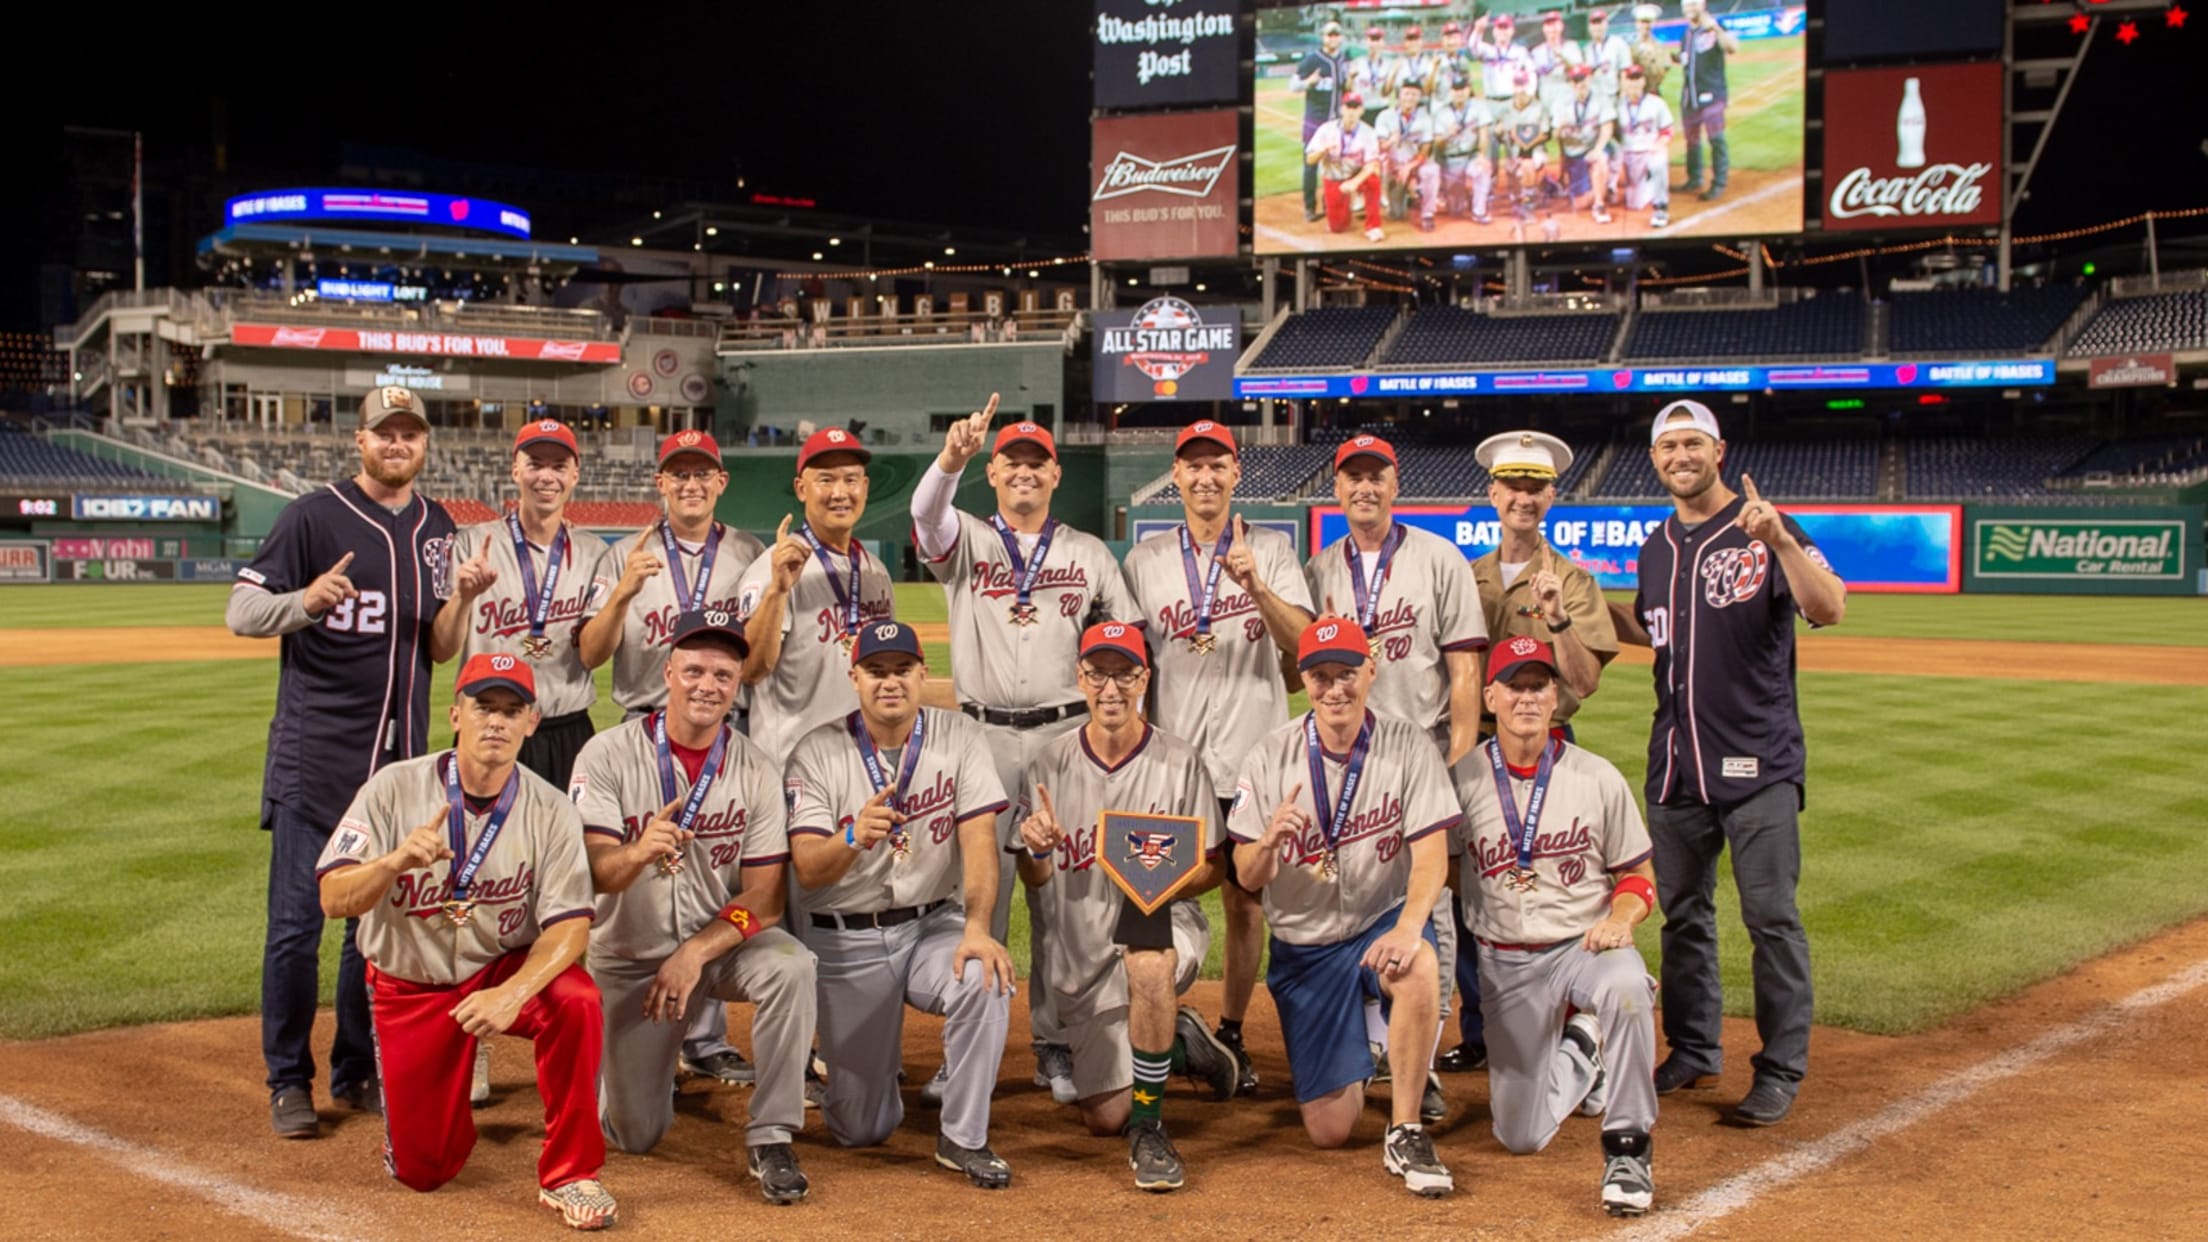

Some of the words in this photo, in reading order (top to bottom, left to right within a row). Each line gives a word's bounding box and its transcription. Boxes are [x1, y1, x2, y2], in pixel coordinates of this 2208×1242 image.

[1096, 11, 1234, 45] Washington
[1137, 48, 1192, 85] Post
[1104, 162, 1221, 187] Budweiser
[1830, 162, 1993, 219] Coca-Cola
[1104, 209, 1131, 223] THIS
[1133, 207, 1169, 222] BUD'S
[1171, 206, 1196, 220] FOR
[358, 331, 393, 348] THIS
[396, 333, 441, 351] BUD'S
[444, 336, 473, 352] FOR
[1184, 327, 1233, 351] GAME
[1380, 378, 1417, 390] BATTLE
[1644, 372, 1685, 386] BATTLE
[1929, 366, 1974, 381] BATTLE
[19, 499, 57, 516] 9:02
[151, 498, 212, 519] FAN
[1554, 520, 1588, 546] OF
[1701, 539, 1768, 609] W
[2075, 560, 2106, 573] Car
[2108, 560, 2163, 573] Rental
[1059, 593, 1083, 617] W
[704, 610, 729, 627] W
[874, 623, 898, 641] W
[1102, 624, 1124, 638] W
[1316, 623, 1339, 643] W
[1384, 633, 1412, 663] W
[491, 655, 515, 671] W
[929, 810, 956, 844] W
[710, 840, 741, 870] W
[1376, 830, 1403, 864] W
[1558, 855, 1586, 887] W
[498, 902, 528, 937] W
